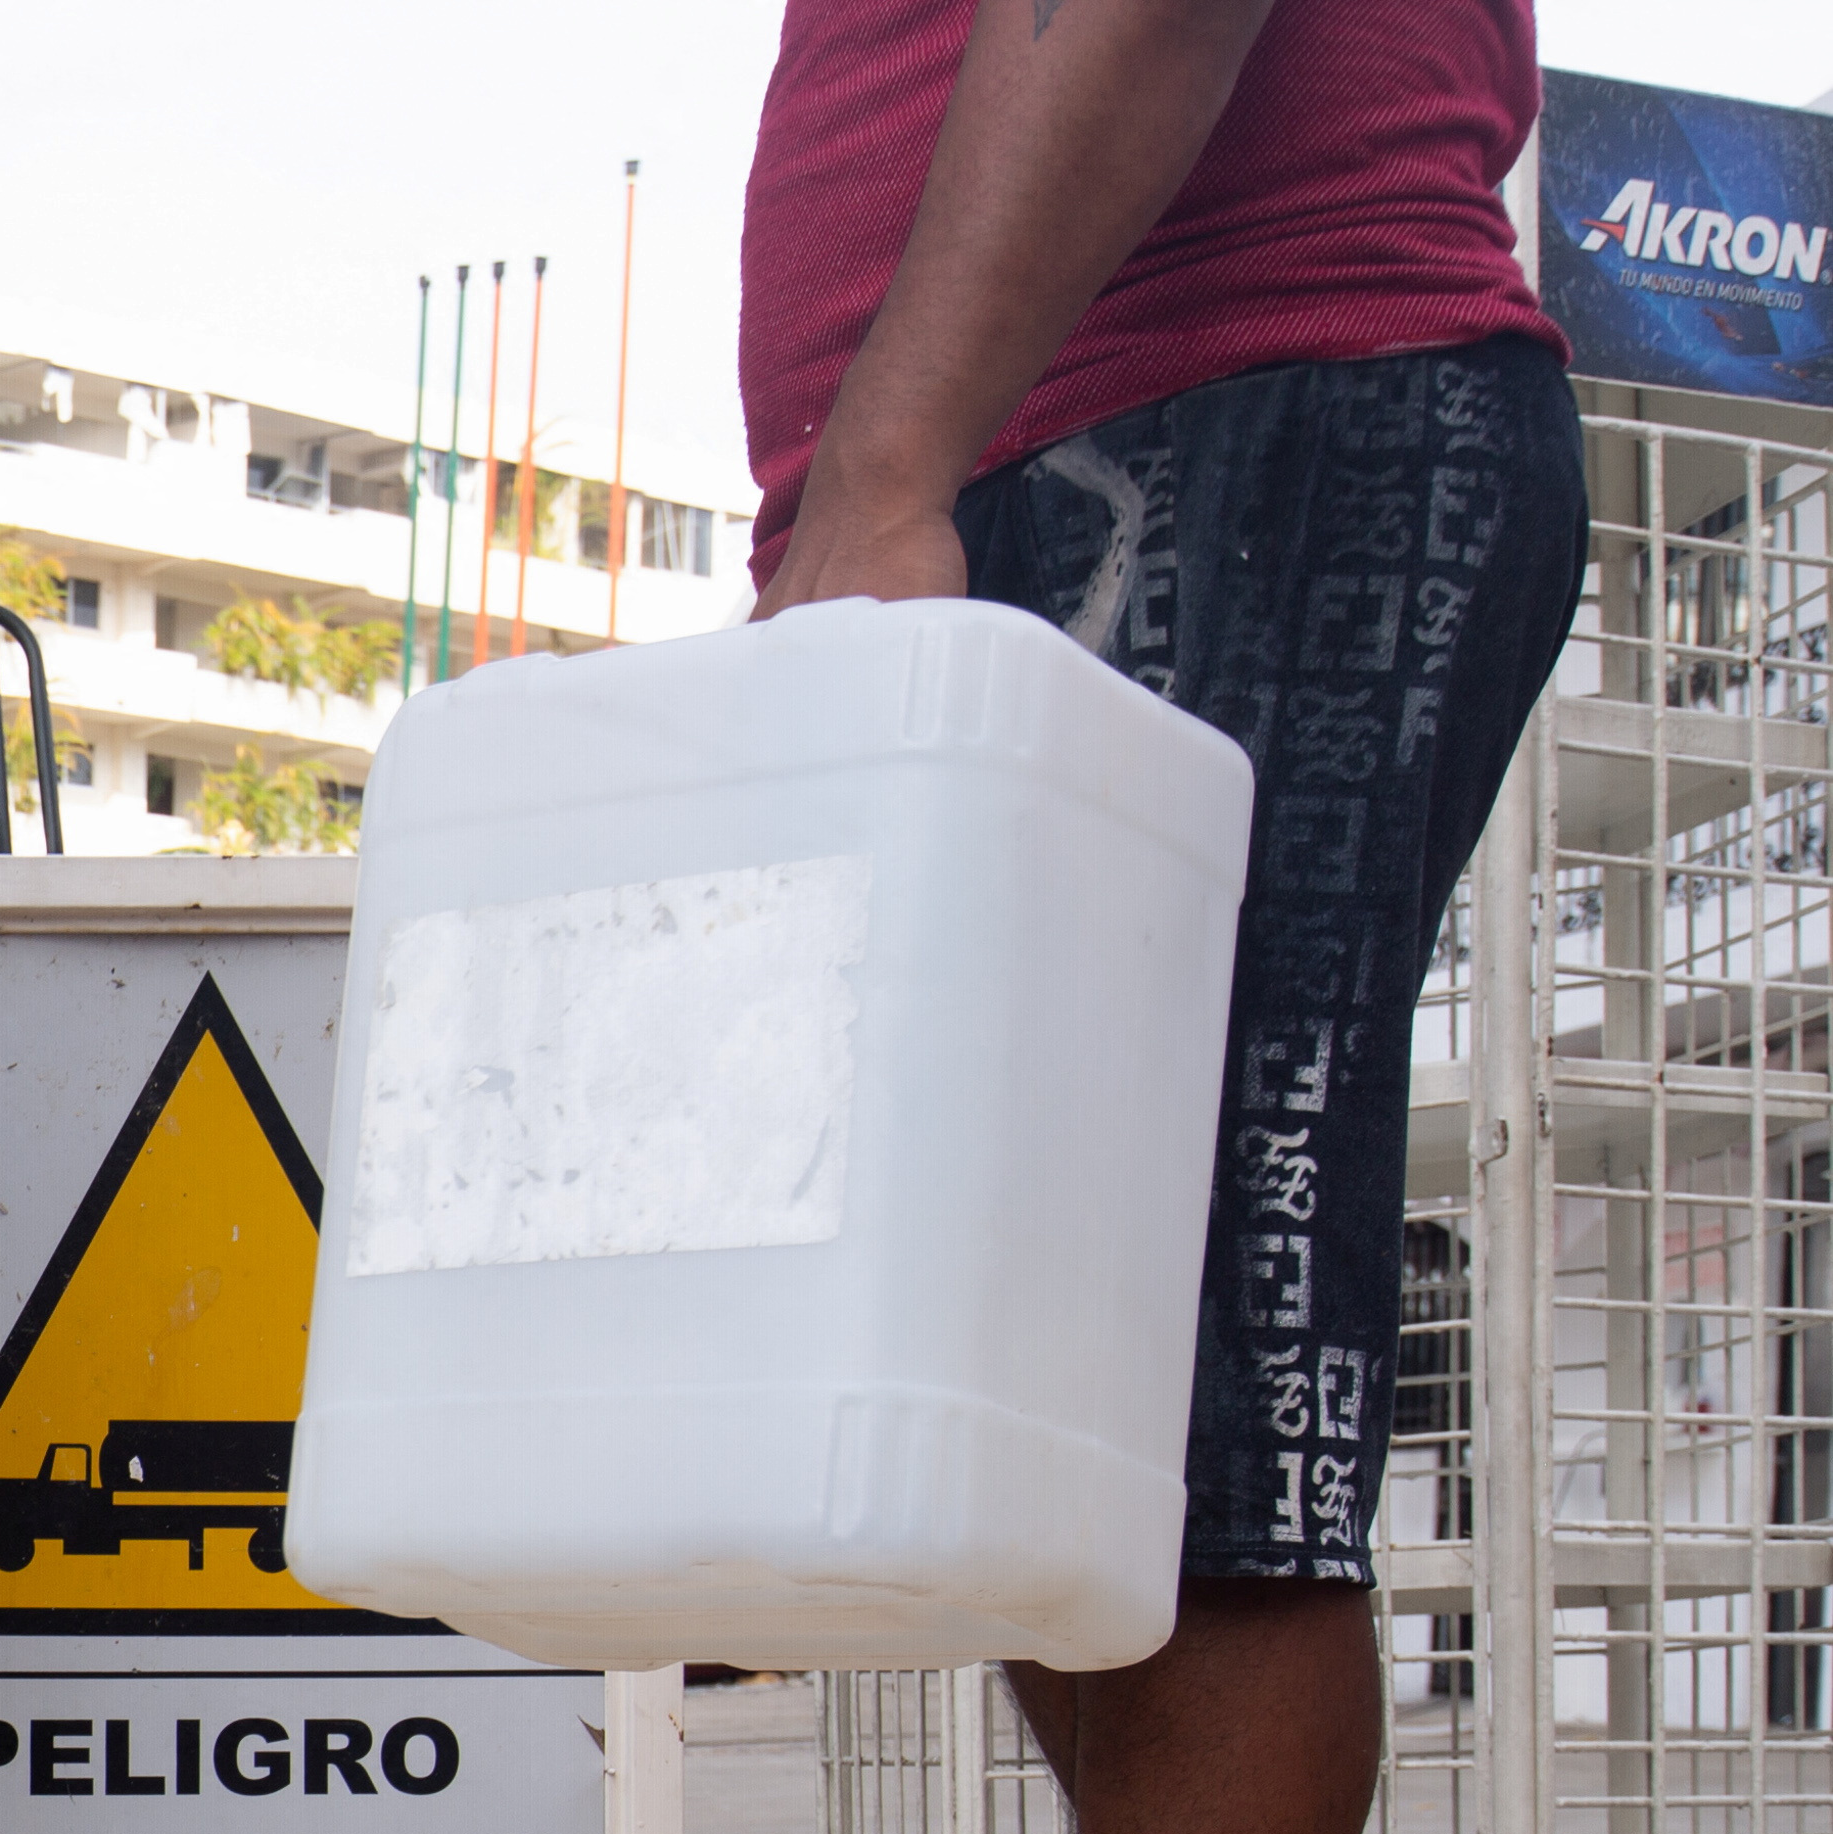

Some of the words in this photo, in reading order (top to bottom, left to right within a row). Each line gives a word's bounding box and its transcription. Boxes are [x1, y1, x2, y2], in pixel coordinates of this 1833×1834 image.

[1579, 178, 1829, 283] AKRON
[1618, 269, 1638, 288] TU
[1641, 271, 1692, 297] MUNDO
[1693, 278, 1715, 299] EN
[1716, 282, 1804, 311] MOVIMIENTO
